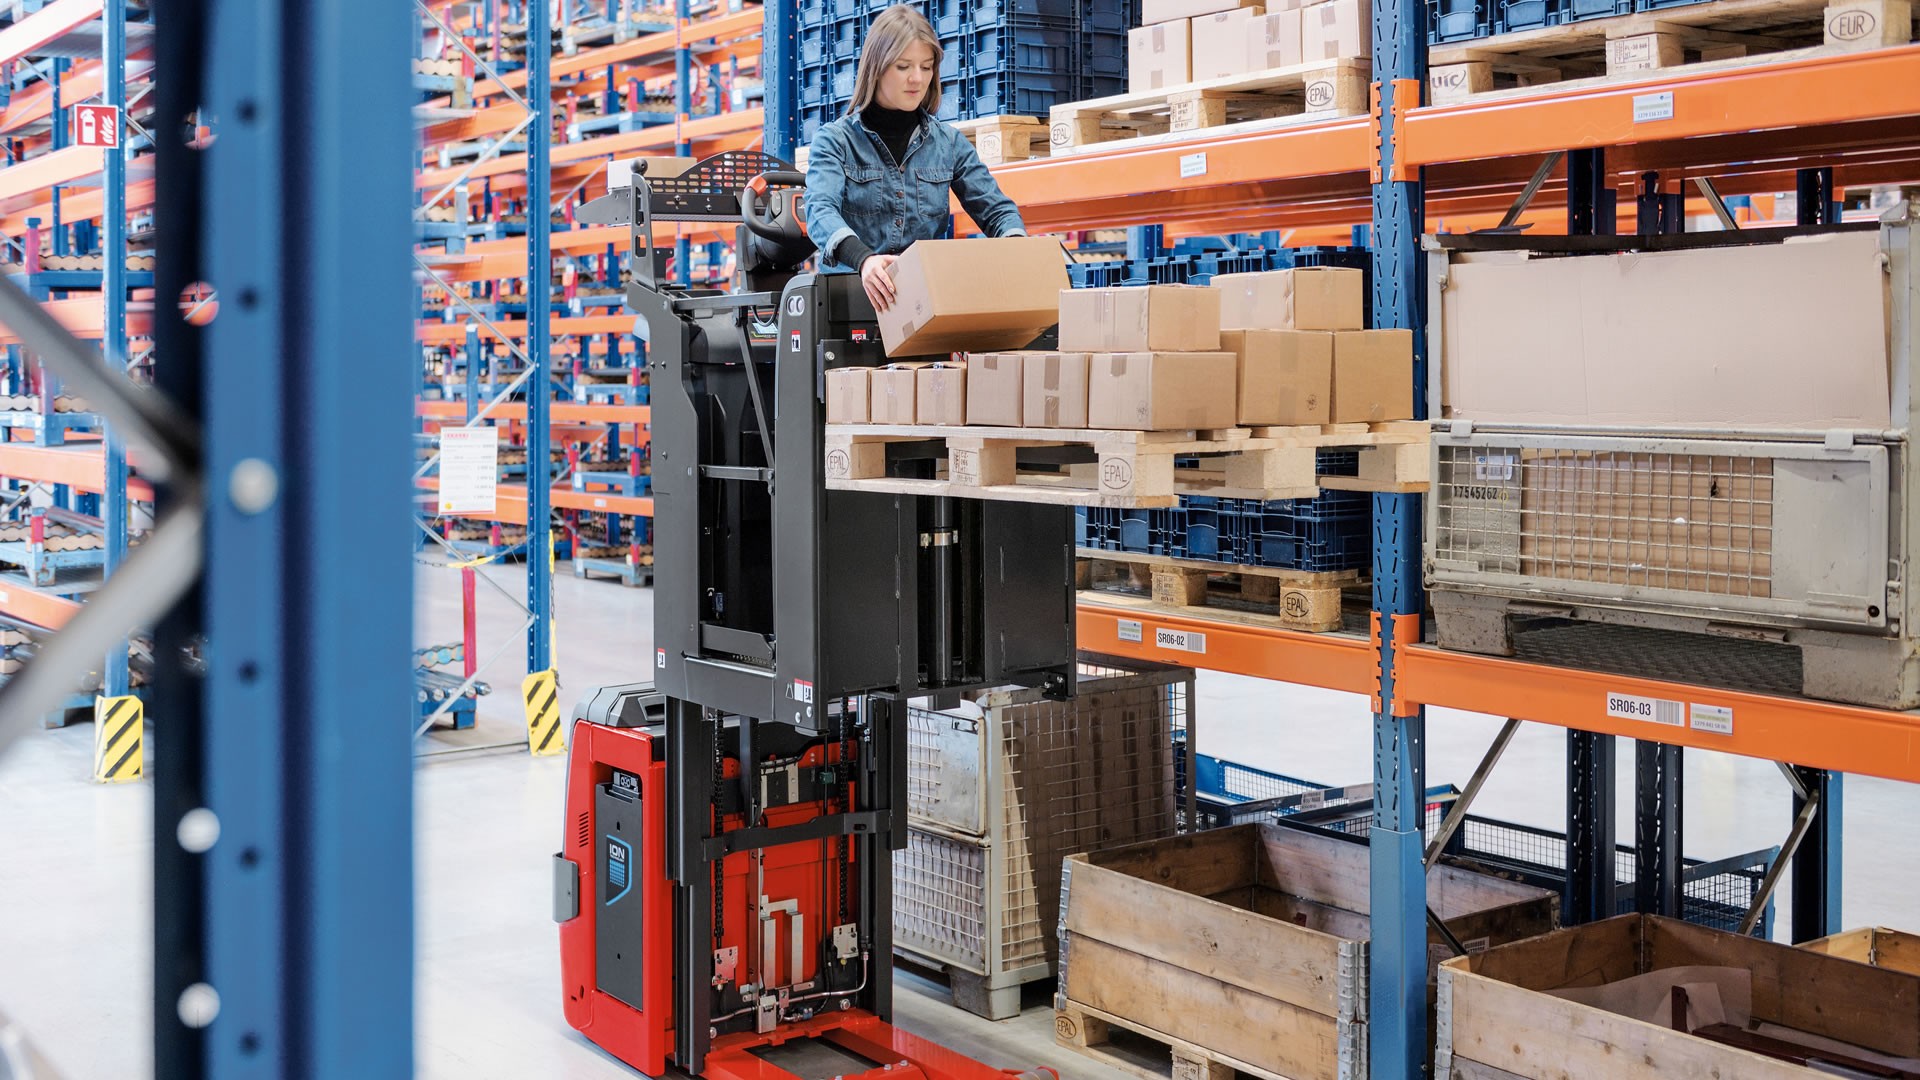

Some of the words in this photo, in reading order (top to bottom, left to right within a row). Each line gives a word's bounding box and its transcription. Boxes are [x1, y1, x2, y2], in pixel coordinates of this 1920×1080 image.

[1840, 15, 1865, 36] EUR
[1310, 86, 1330, 102] EPAL
[830, 455, 846, 470] EPAL
[1105, 465, 1128, 482] EPAL
[1453, 485, 1498, 499] 17545262
[1286, 597, 1305, 613] EPAL
[1158, 632, 1185, 646] SR06-02
[1610, 698, 1651, 716] SR06-03
[609, 843, 625, 860] ION
[1057, 1020, 1073, 1036] EPAL
